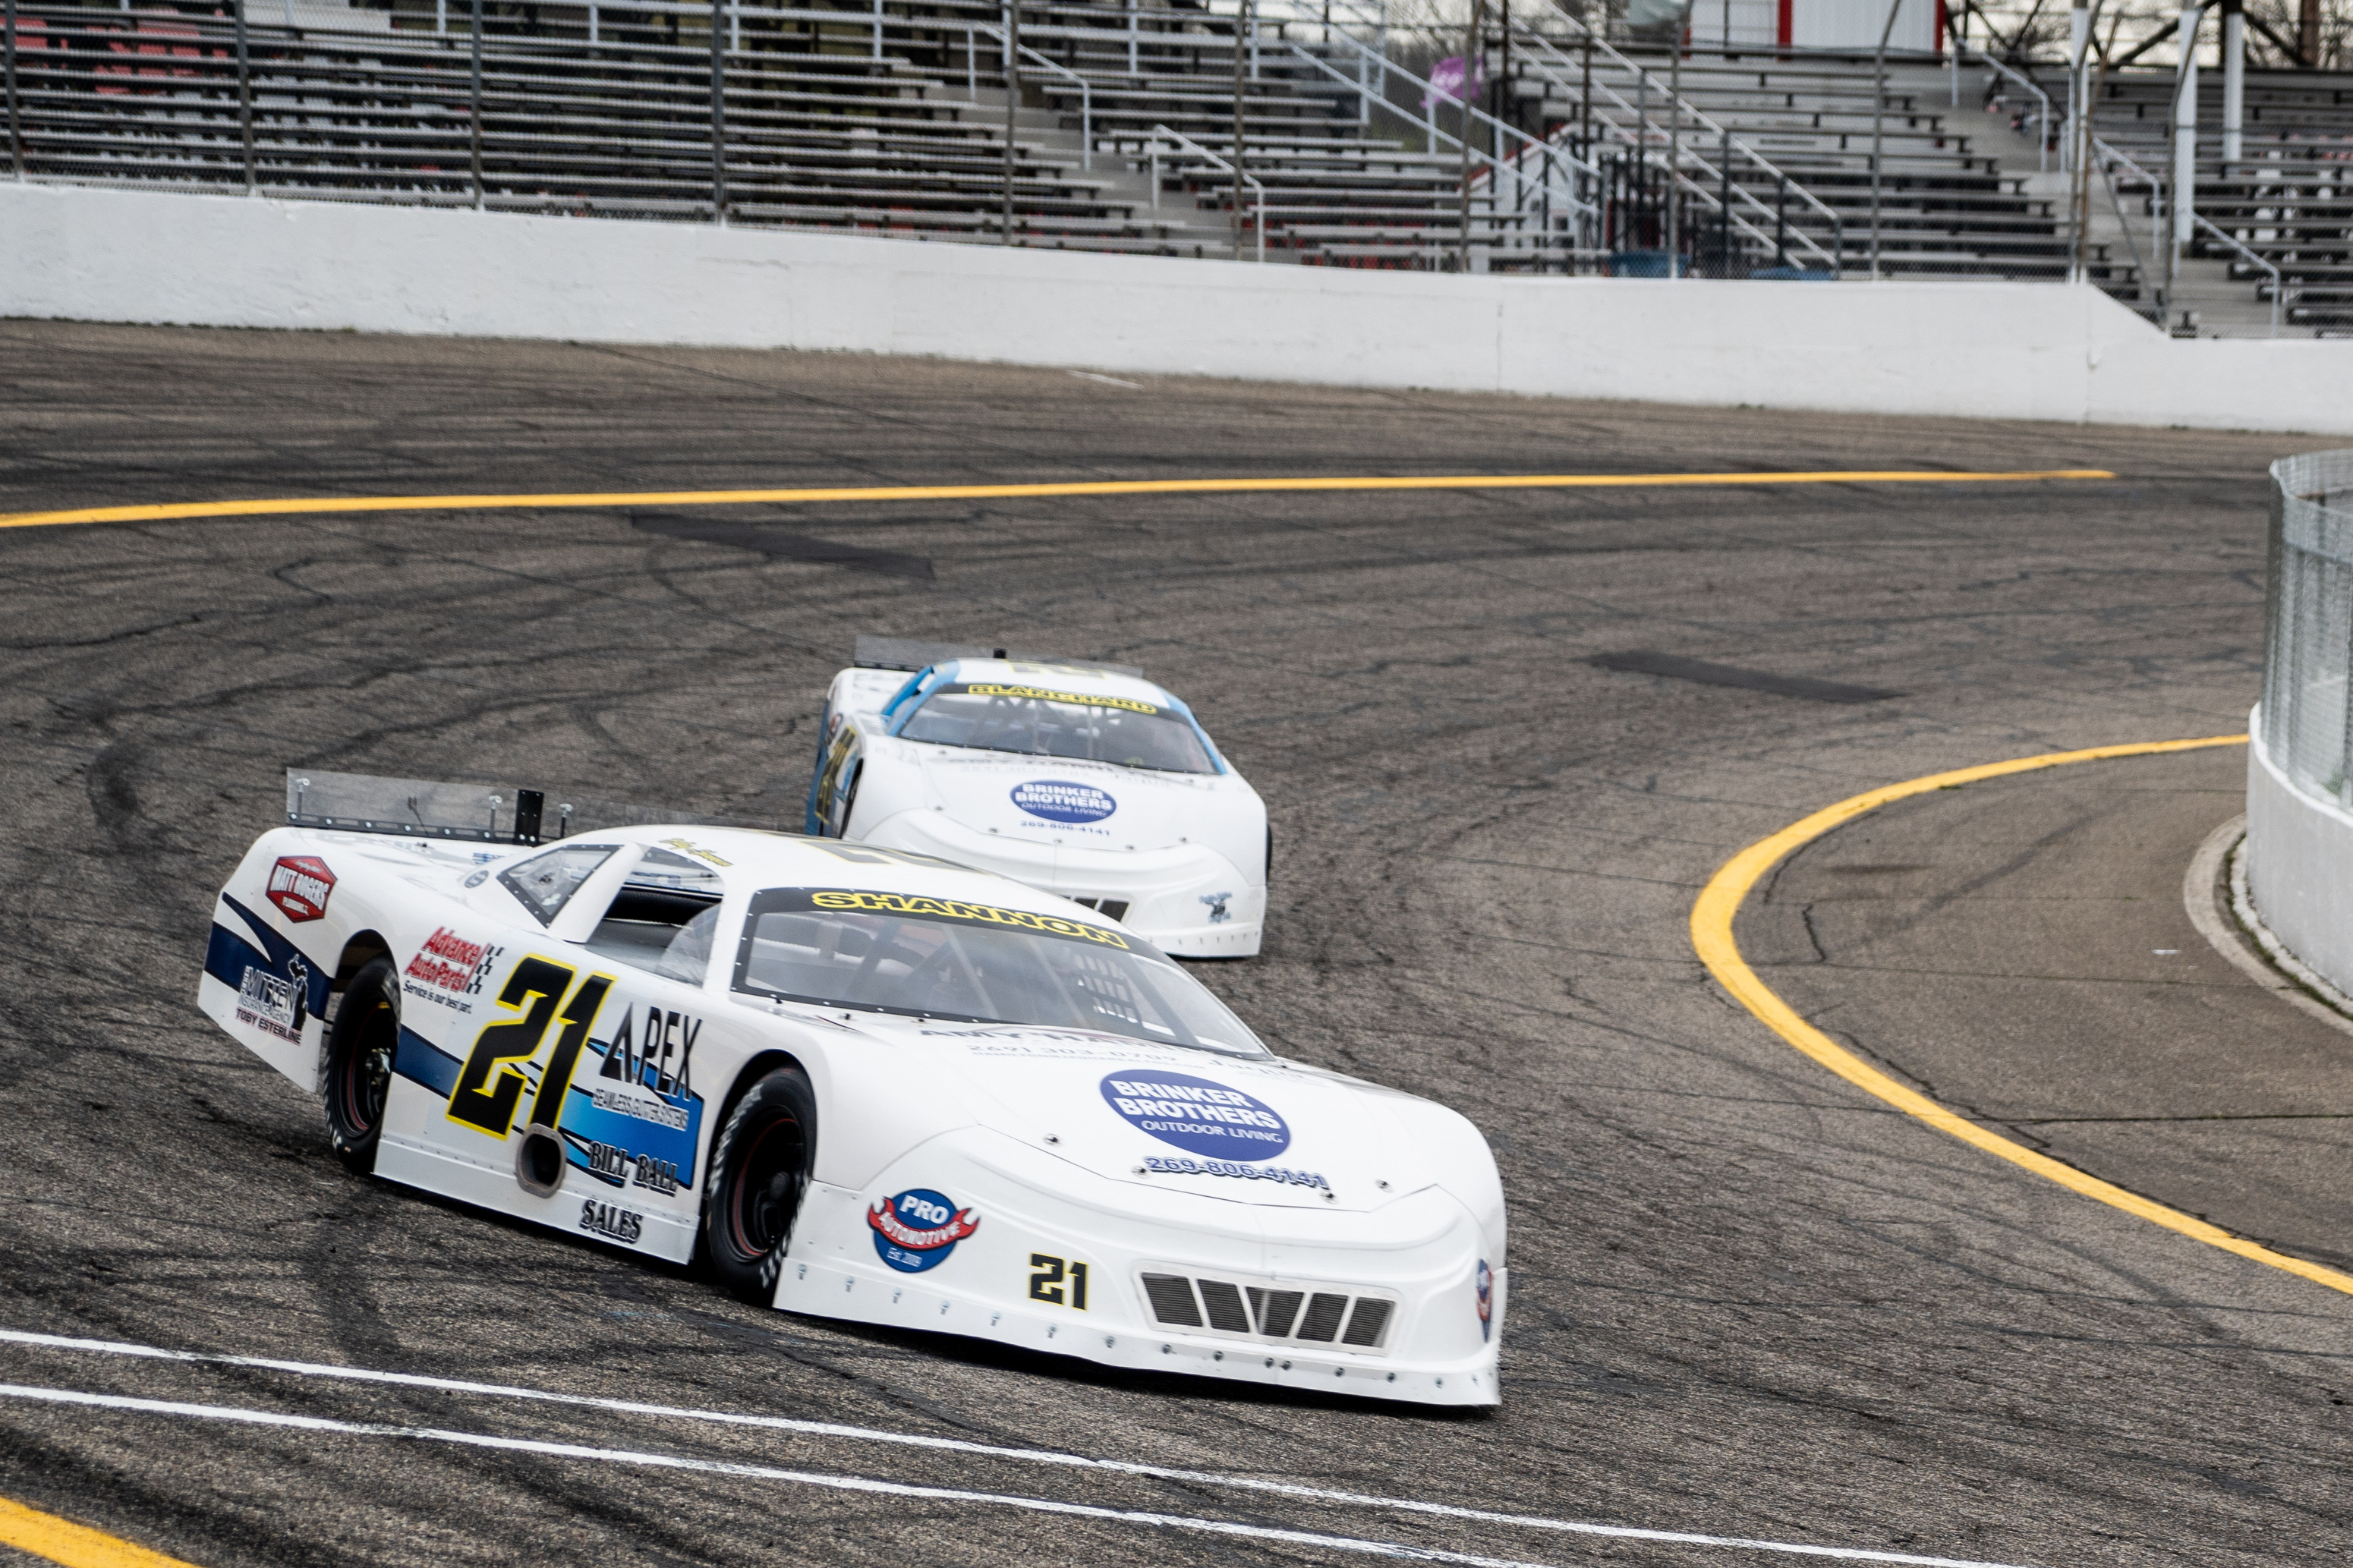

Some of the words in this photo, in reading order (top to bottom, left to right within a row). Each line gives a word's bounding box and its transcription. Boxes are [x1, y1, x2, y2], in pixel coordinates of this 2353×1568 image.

[969, 685, 1158, 715] BLANCHARD
[1015, 792, 1113, 811] BROTHERS
[1022, 784, 1105, 799] BRINKER
[1021, 802, 1073, 813] OUTDOOR
[1074, 807, 1108, 817] LIVING
[1020, 820, 1111, 836] 269-806-4141
[270, 864, 298, 893] MATT
[293, 872, 330, 912] ROGERS
[811, 892, 1130, 949] SHANNON
[421, 925, 482, 968] Advance
[247, 966, 299, 1012] MITTEN
[402, 980, 427, 999] Service
[404, 953, 437, 985] Auto
[438, 962, 467, 993] Parts
[236, 1006, 258, 1026] TOBY
[257, 1017, 302, 1047] ESTERLINE
[445, 952, 619, 1142] 21
[600, 1001, 704, 1101] APEX
[1108, 1080, 1256, 1108] BRINKER
[1113, 1097, 1283, 1129] BROTHERS
[1141, 1120, 1227, 1137] OUTDOOR
[1227, 1127, 1284, 1144] LIVING
[587, 1140, 629, 1182] BILL
[632, 1154, 679, 1198] BALL
[1144, 1155, 1331, 1190] 269-806-4141
[579, 1199, 644, 1245] SALES
[899, 1195, 950, 1225] PRO
[878, 1211, 960, 1246] AUTOMOTIVE
[1028, 1252, 1088, 1311] 21
